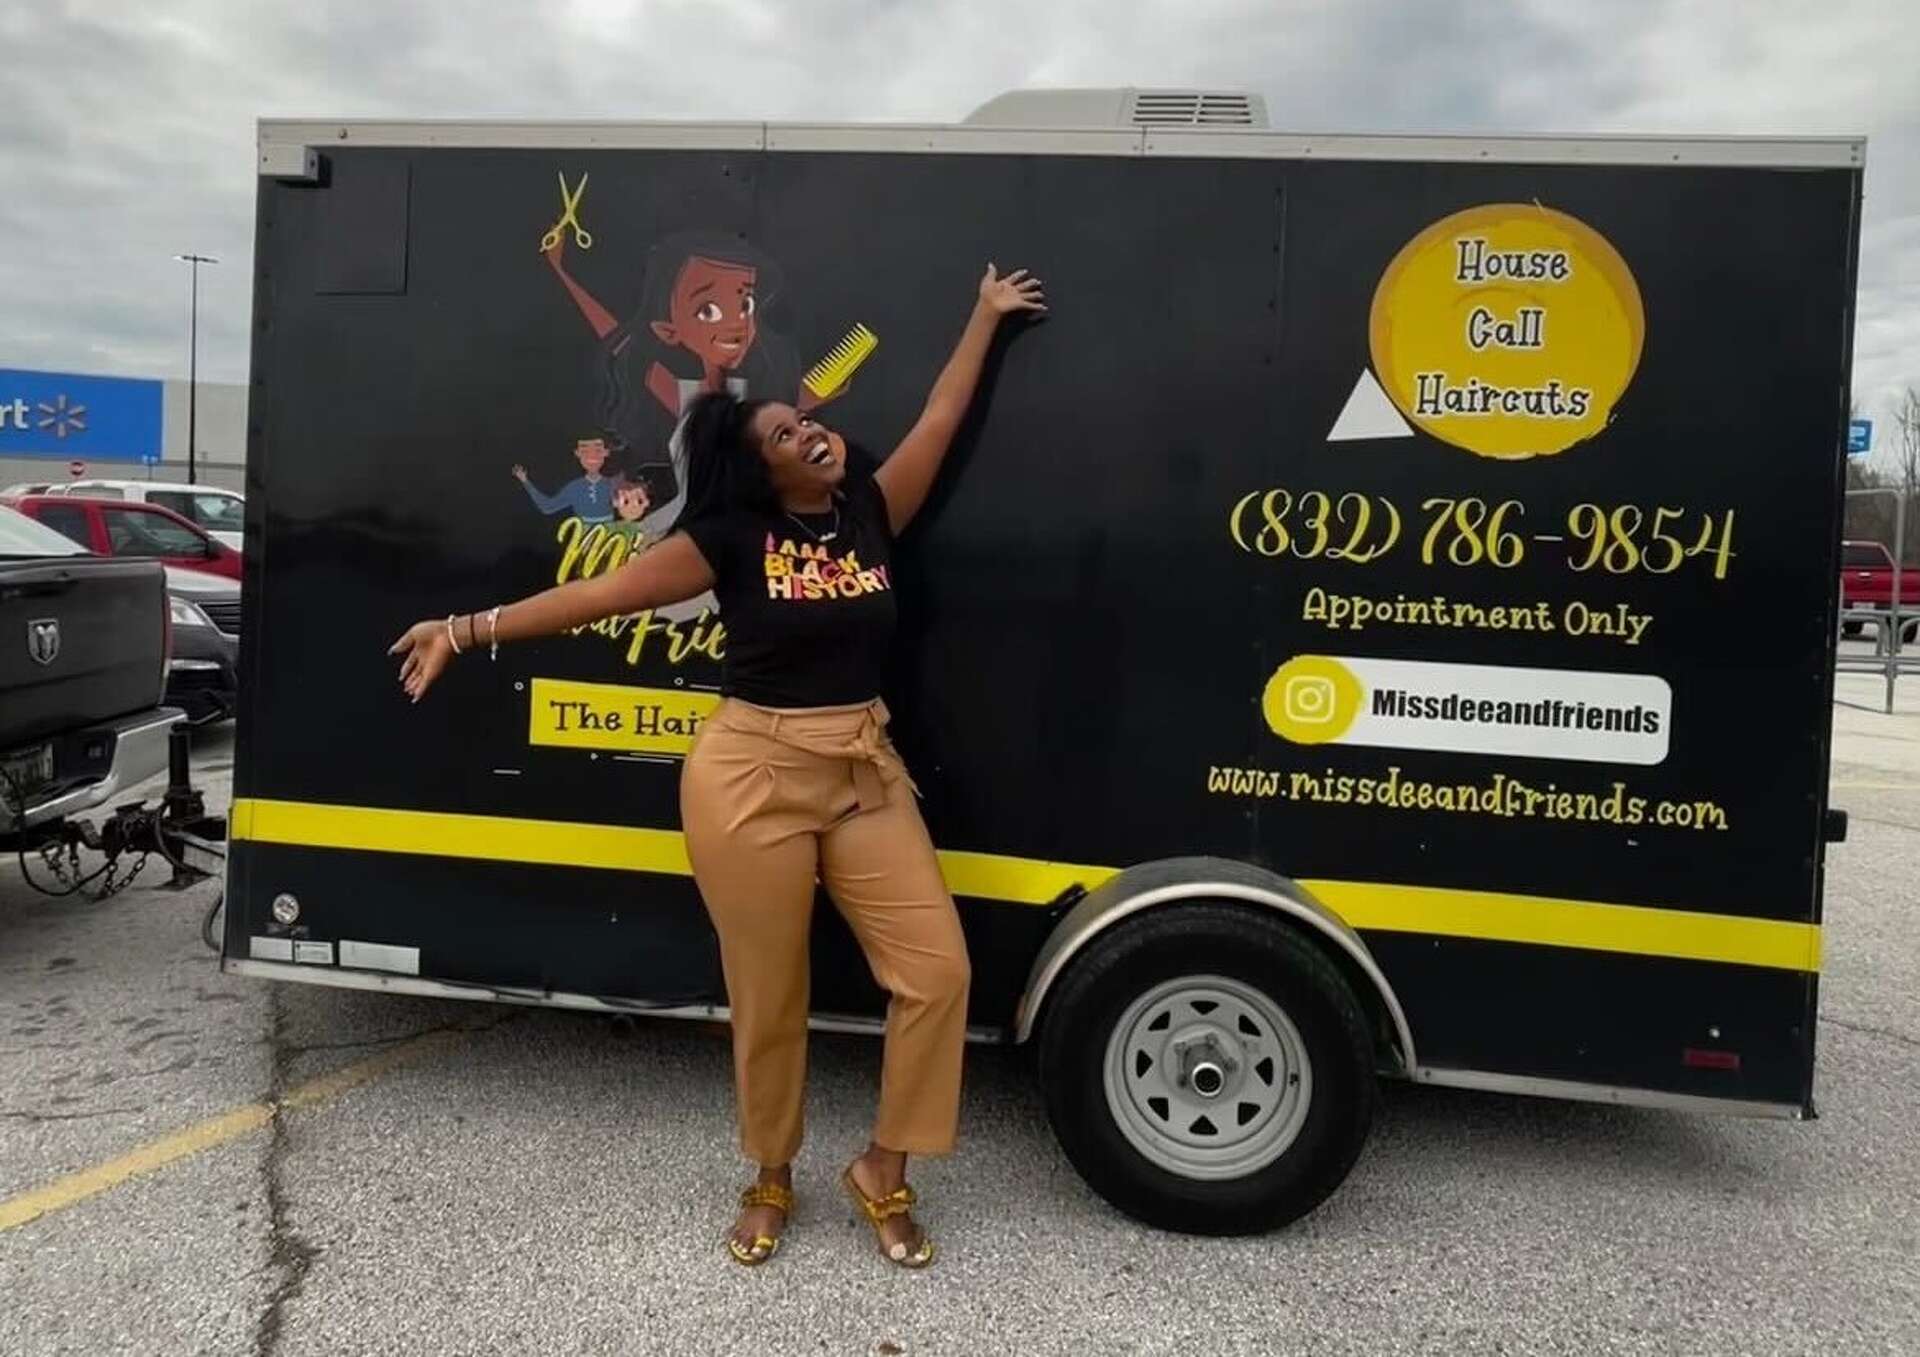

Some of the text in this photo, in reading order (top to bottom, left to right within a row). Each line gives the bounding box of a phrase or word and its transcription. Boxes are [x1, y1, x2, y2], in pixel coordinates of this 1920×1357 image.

[1456, 239, 1569, 281] House
[1468, 308, 1544, 348] Call
[1416, 374, 1590, 417] Haircuts
[779, 539, 830, 561] AM
[1229, 488, 1738, 580] (832) 786-9854
[764, 549, 862, 584] BLACK
[766, 564, 891, 600] HISTORY
[1302, 587, 1654, 645] Appointment Only
[549, 700, 707, 736] The Hai
[1371, 688, 1660, 735] Missdeeandfriends
[1207, 765, 1729, 831] www.missdeeandfriends.com
